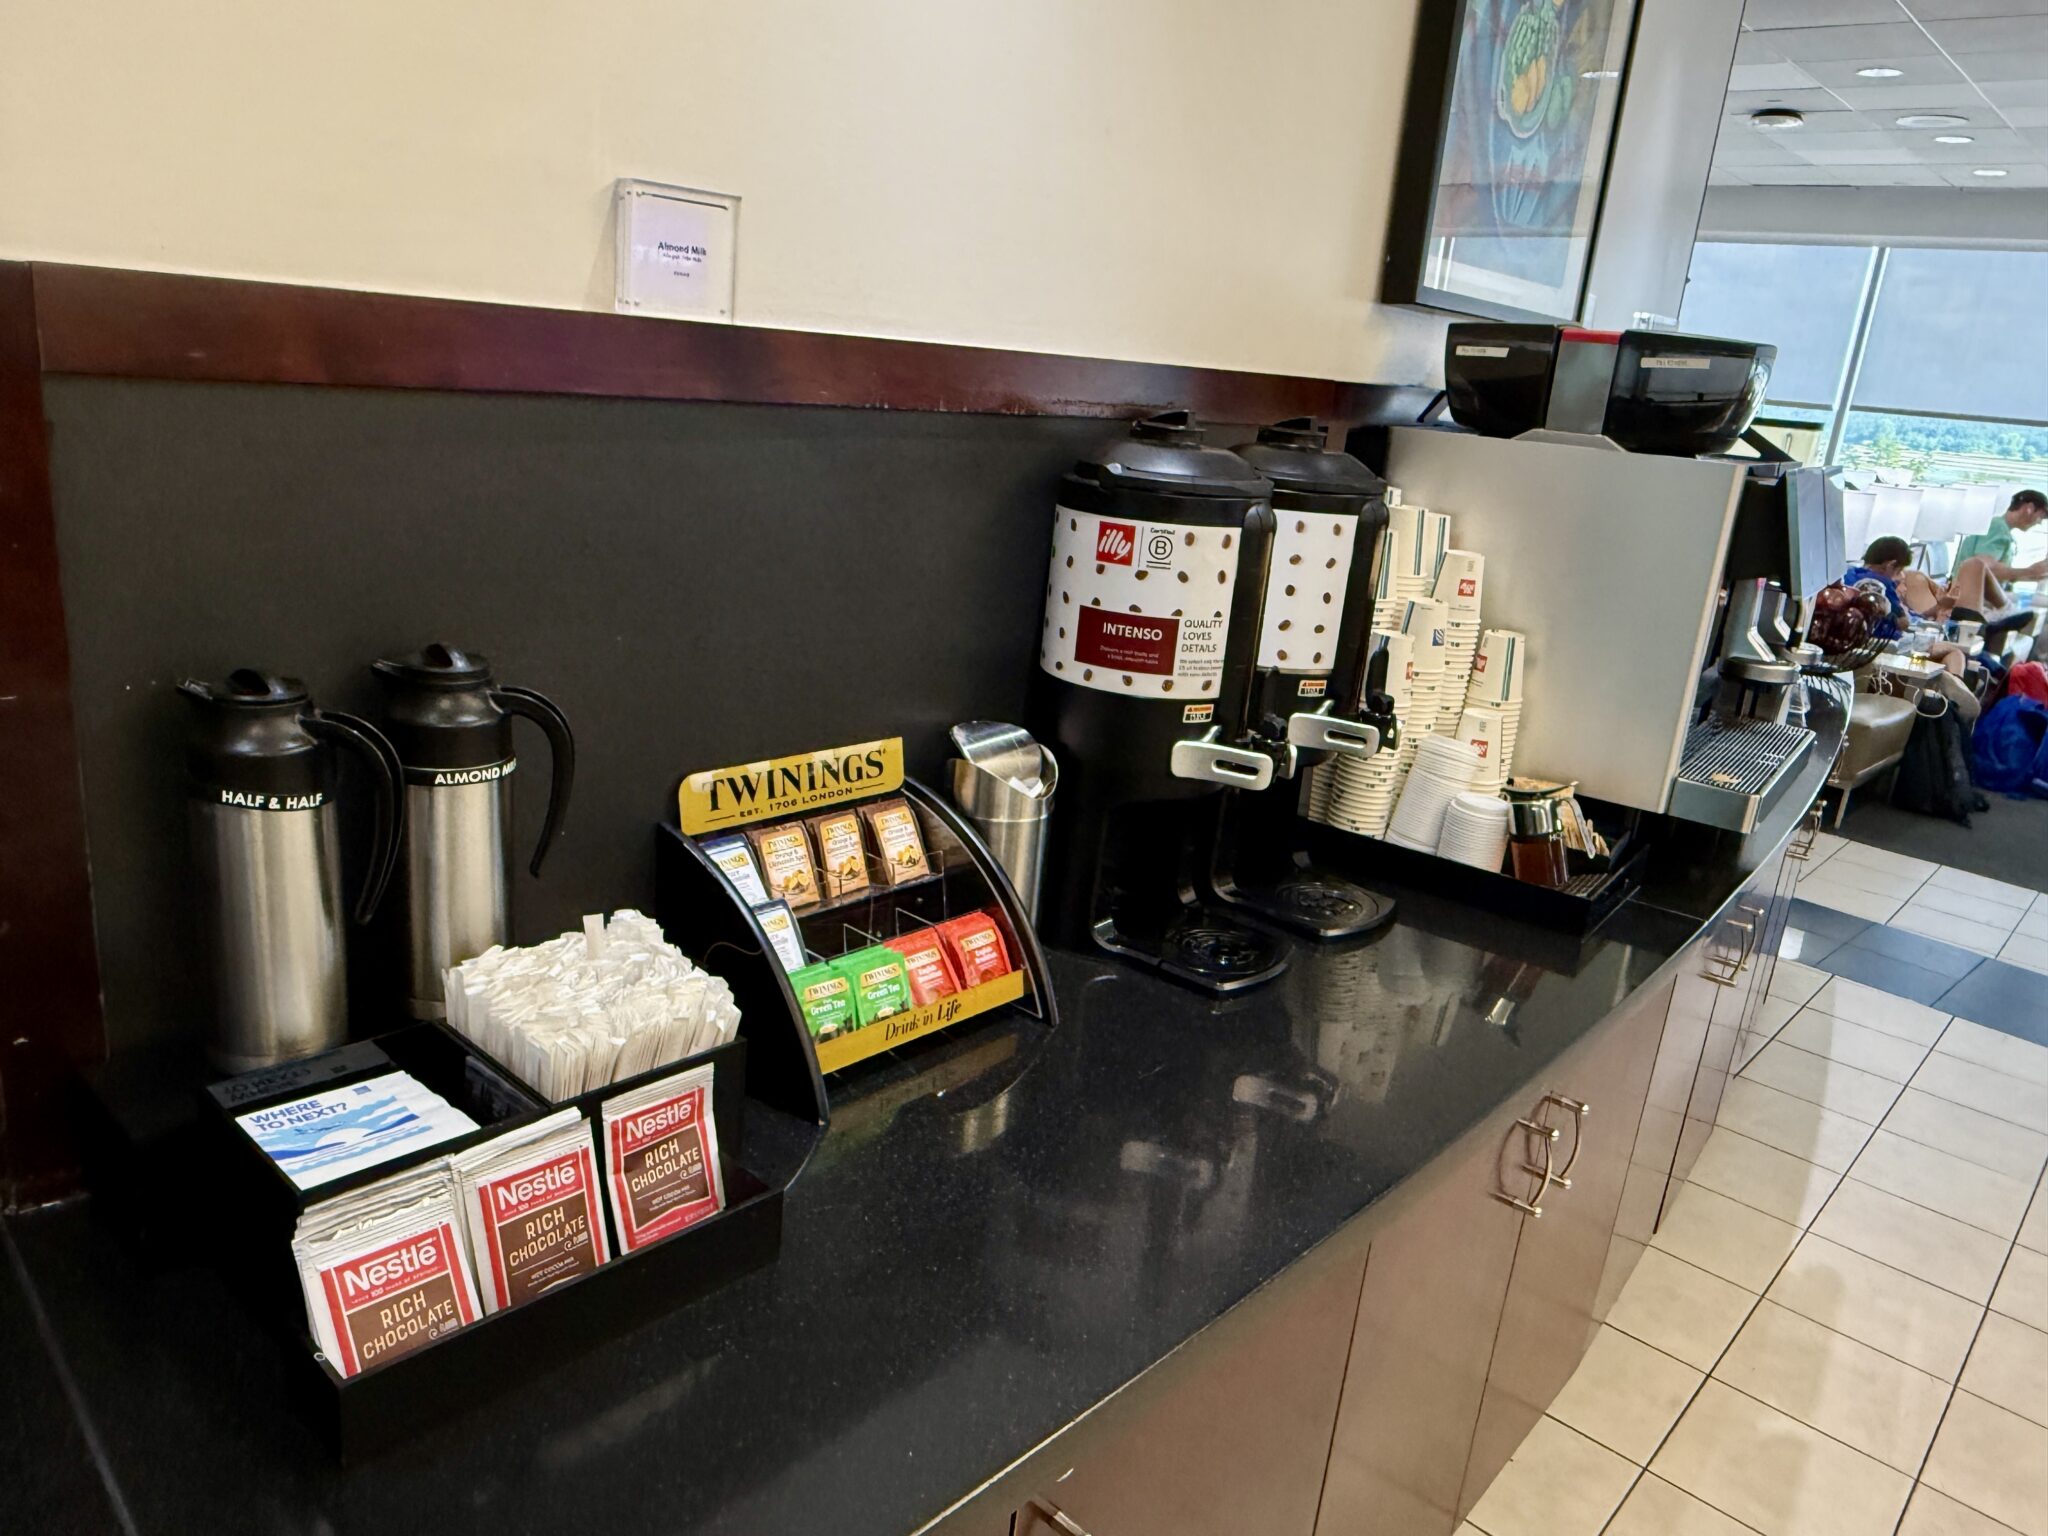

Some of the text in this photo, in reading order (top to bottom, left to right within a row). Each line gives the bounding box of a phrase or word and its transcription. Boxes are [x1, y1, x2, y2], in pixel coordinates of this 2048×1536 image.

[658, 241, 706, 256] Almond Milk
[1099, 529, 1131, 560] illy
[1103, 622, 1163, 641] INTENSO
[1183, 632, 1212, 640] LOVES
[1184, 620, 1223, 628] QUALITY
[1181, 644, 1217, 652] DETAILS
[434, 767, 500, 785] ALMOND
[702, 750, 885, 812] TWININGS
[222, 790, 323, 809] HALF & HALF
[739, 788, 853, 818] EST. 1706 LONDON
[867, 987, 888, 1000] Green
[811, 1004, 832, 1016] Green
[885, 999, 962, 1041] Drink in Life
[249, 1100, 323, 1123] WHERE
[255, 1102, 347, 1131] TO NEXT?
[644, 1138, 680, 1168] RICH
[631, 1147, 700, 1193] CHOCOLATE
[525, 1206, 565, 1240] RICH
[509, 1215, 586, 1267] CHOCOLATE
[380, 1289, 427, 1329] RICH
[363, 1299, 454, 1360] CHOCOLATE
